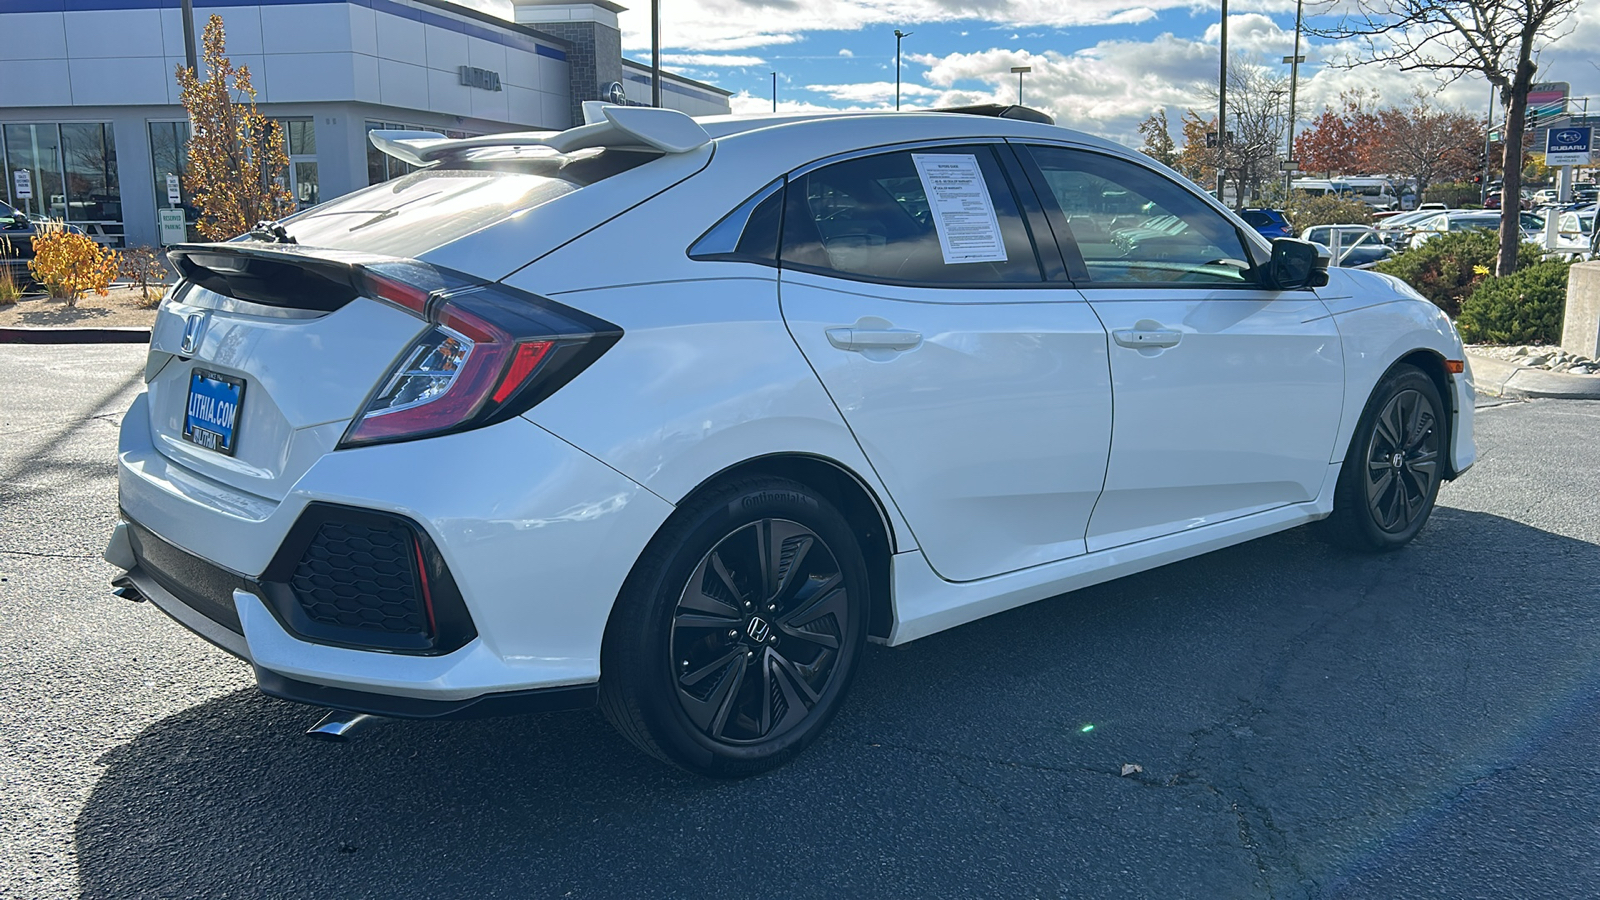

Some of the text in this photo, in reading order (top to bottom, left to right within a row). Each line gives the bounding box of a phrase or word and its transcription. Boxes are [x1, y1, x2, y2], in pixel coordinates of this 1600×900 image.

[458, 65, 502, 92] LITHIA
[188, 392, 238, 429] LITHIA.COM
[199, 429, 217, 450] LITHIA
[741, 491, 799, 509] Continental
